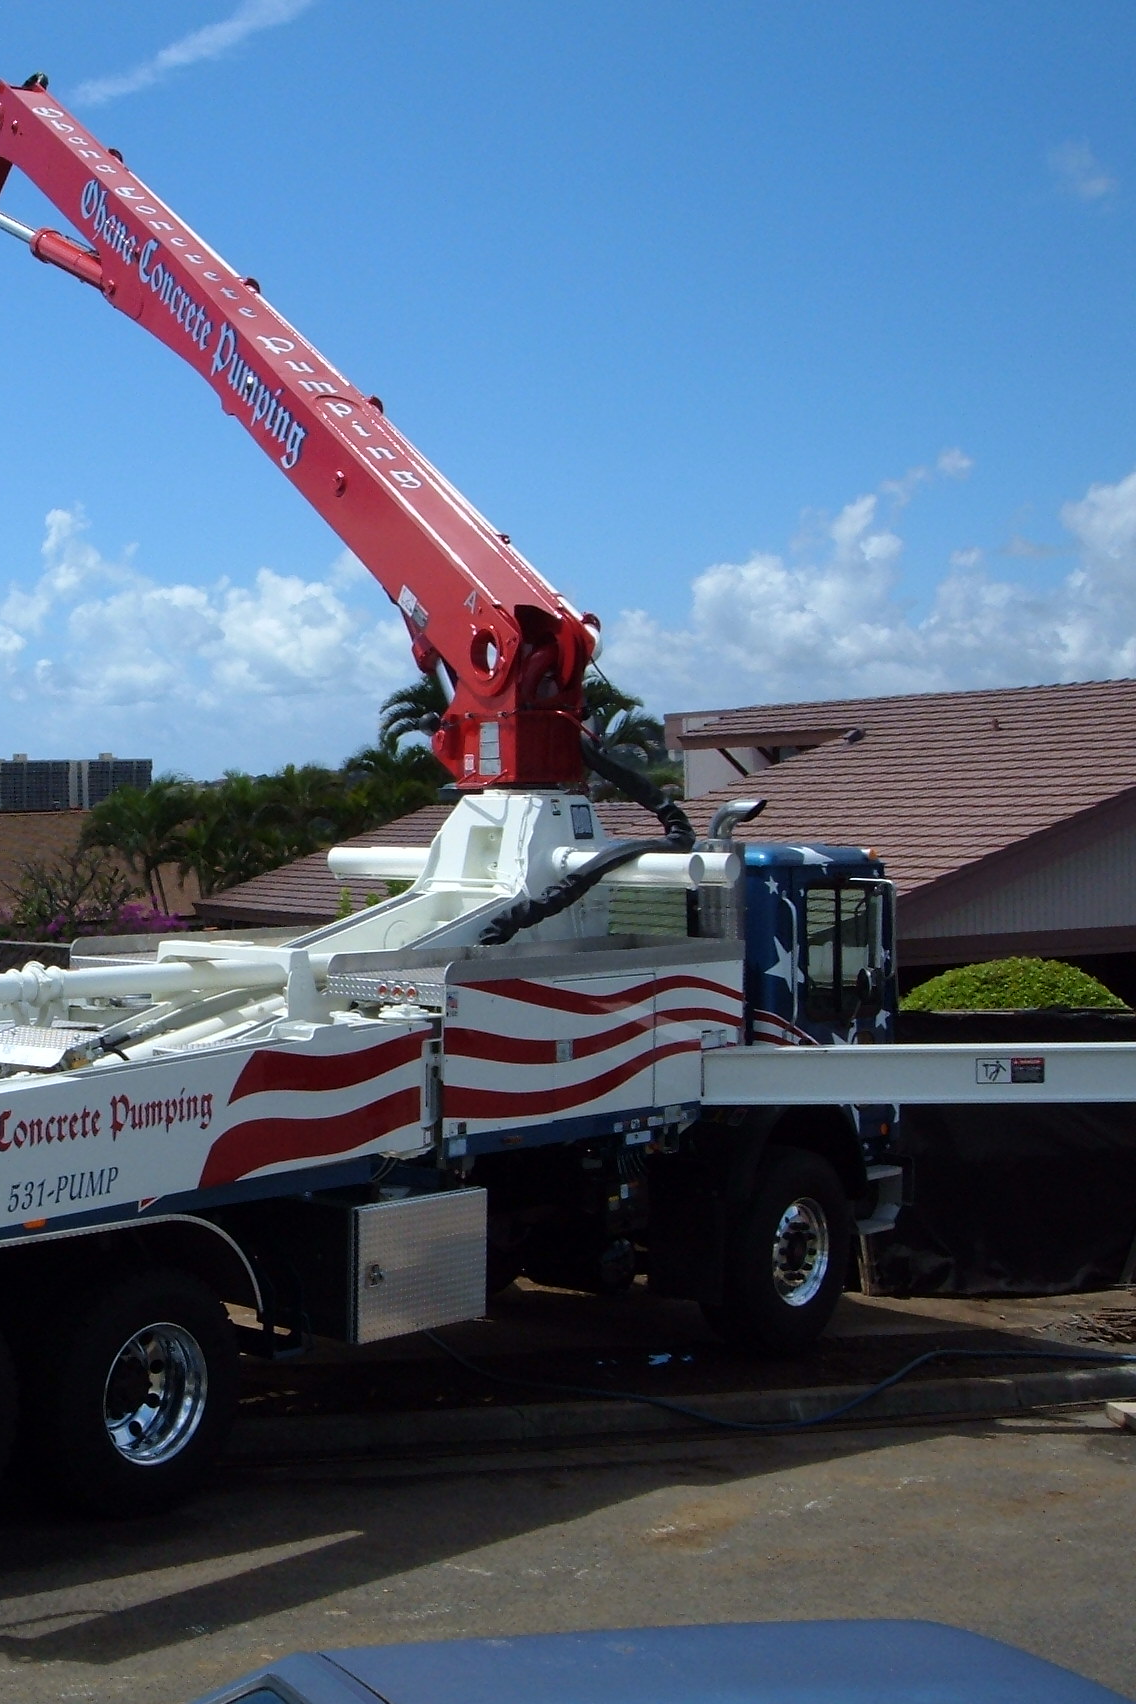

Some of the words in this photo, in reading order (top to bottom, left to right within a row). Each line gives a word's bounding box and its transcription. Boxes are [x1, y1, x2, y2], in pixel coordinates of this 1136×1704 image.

[79, 177, 139, 268] Ohana
[137, 239, 213, 352] Concrete
[209, 319, 308, 470] Pumping
[464, 591, 478, 613] A
[109, 1087, 214, 1143] Pumping
[6, 1165, 120, 1213] 531-PUMP
